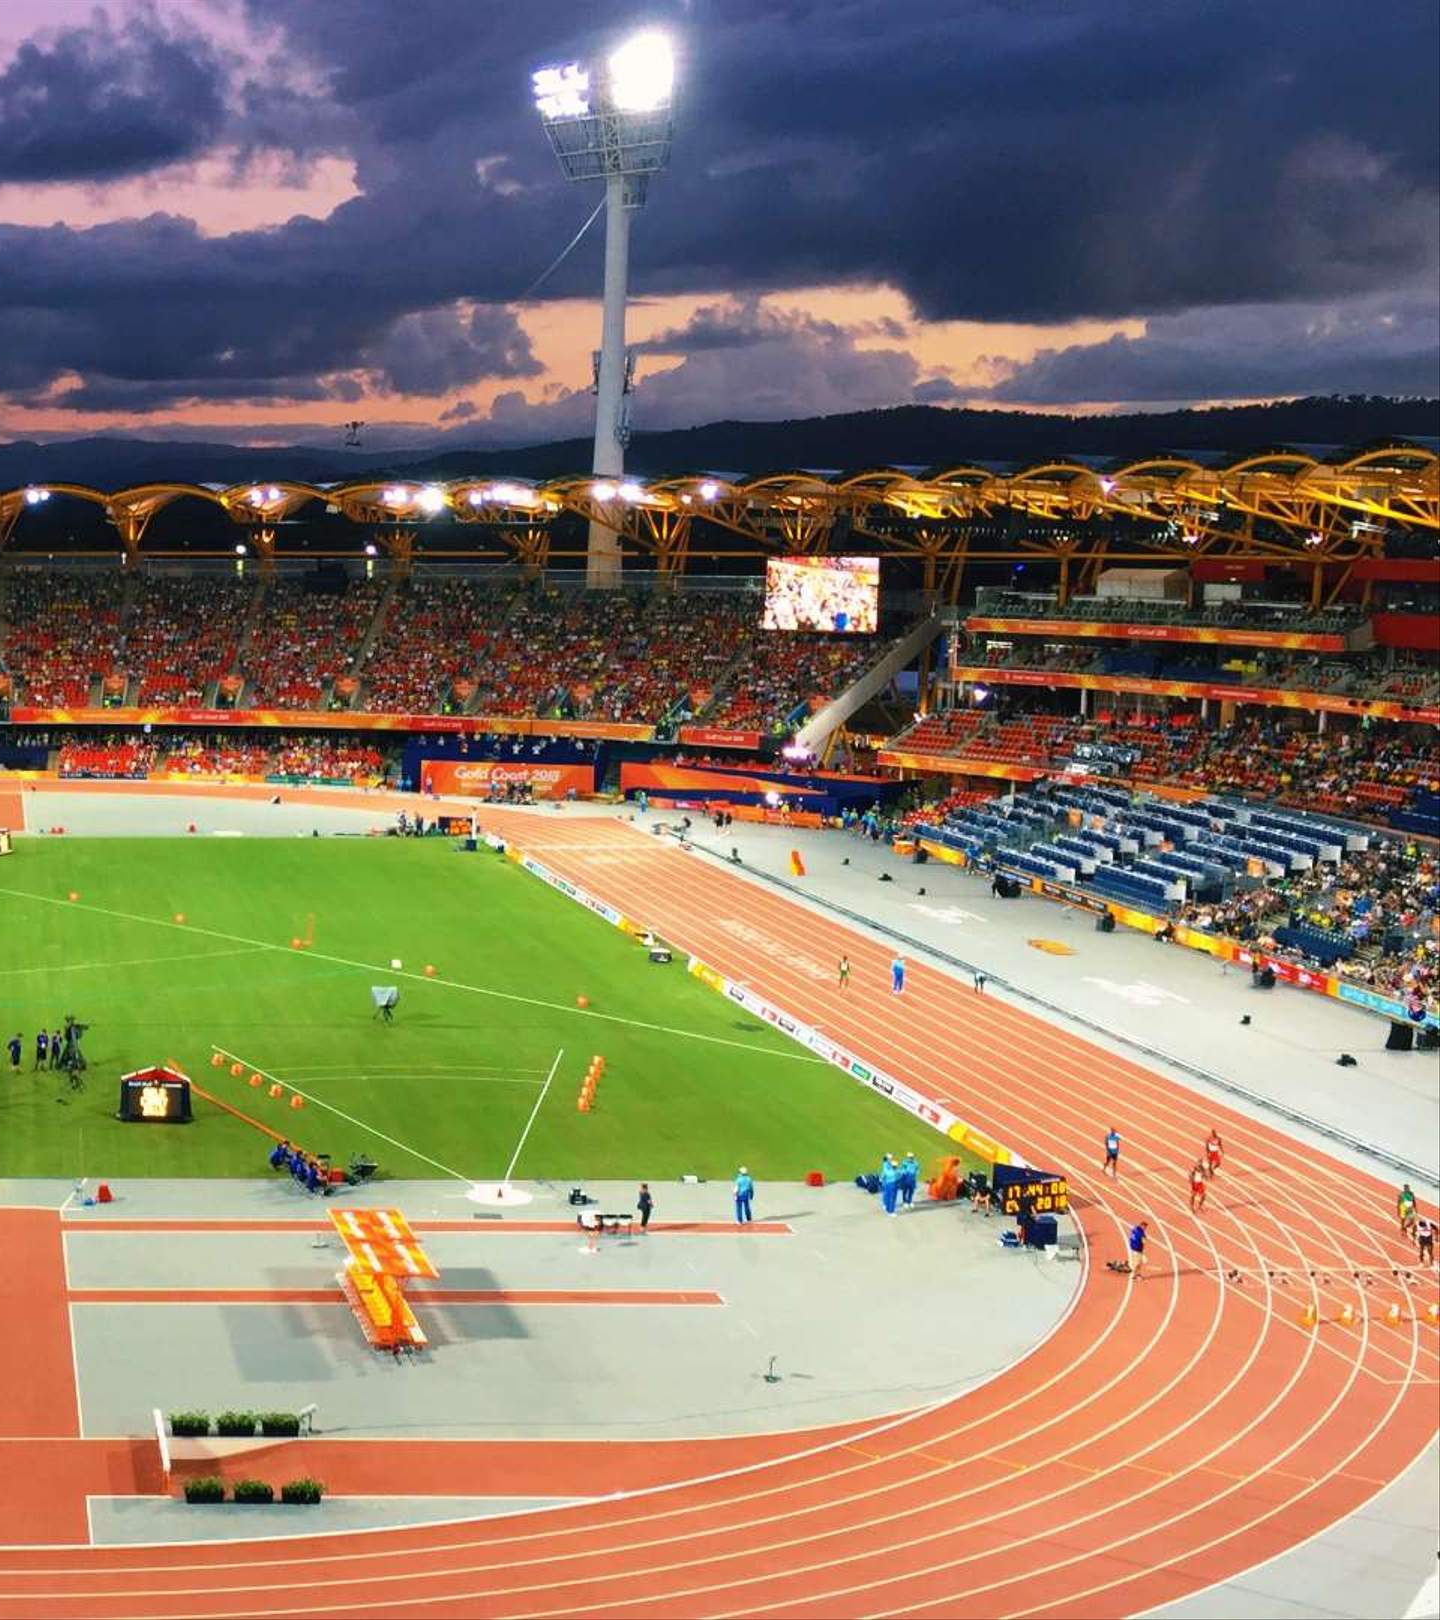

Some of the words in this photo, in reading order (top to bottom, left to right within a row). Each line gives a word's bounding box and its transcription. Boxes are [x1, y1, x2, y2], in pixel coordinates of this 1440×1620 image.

[453, 766, 488, 780] Gold
[491, 767, 529, 781] Coast
[532, 769, 561, 782] 2018
